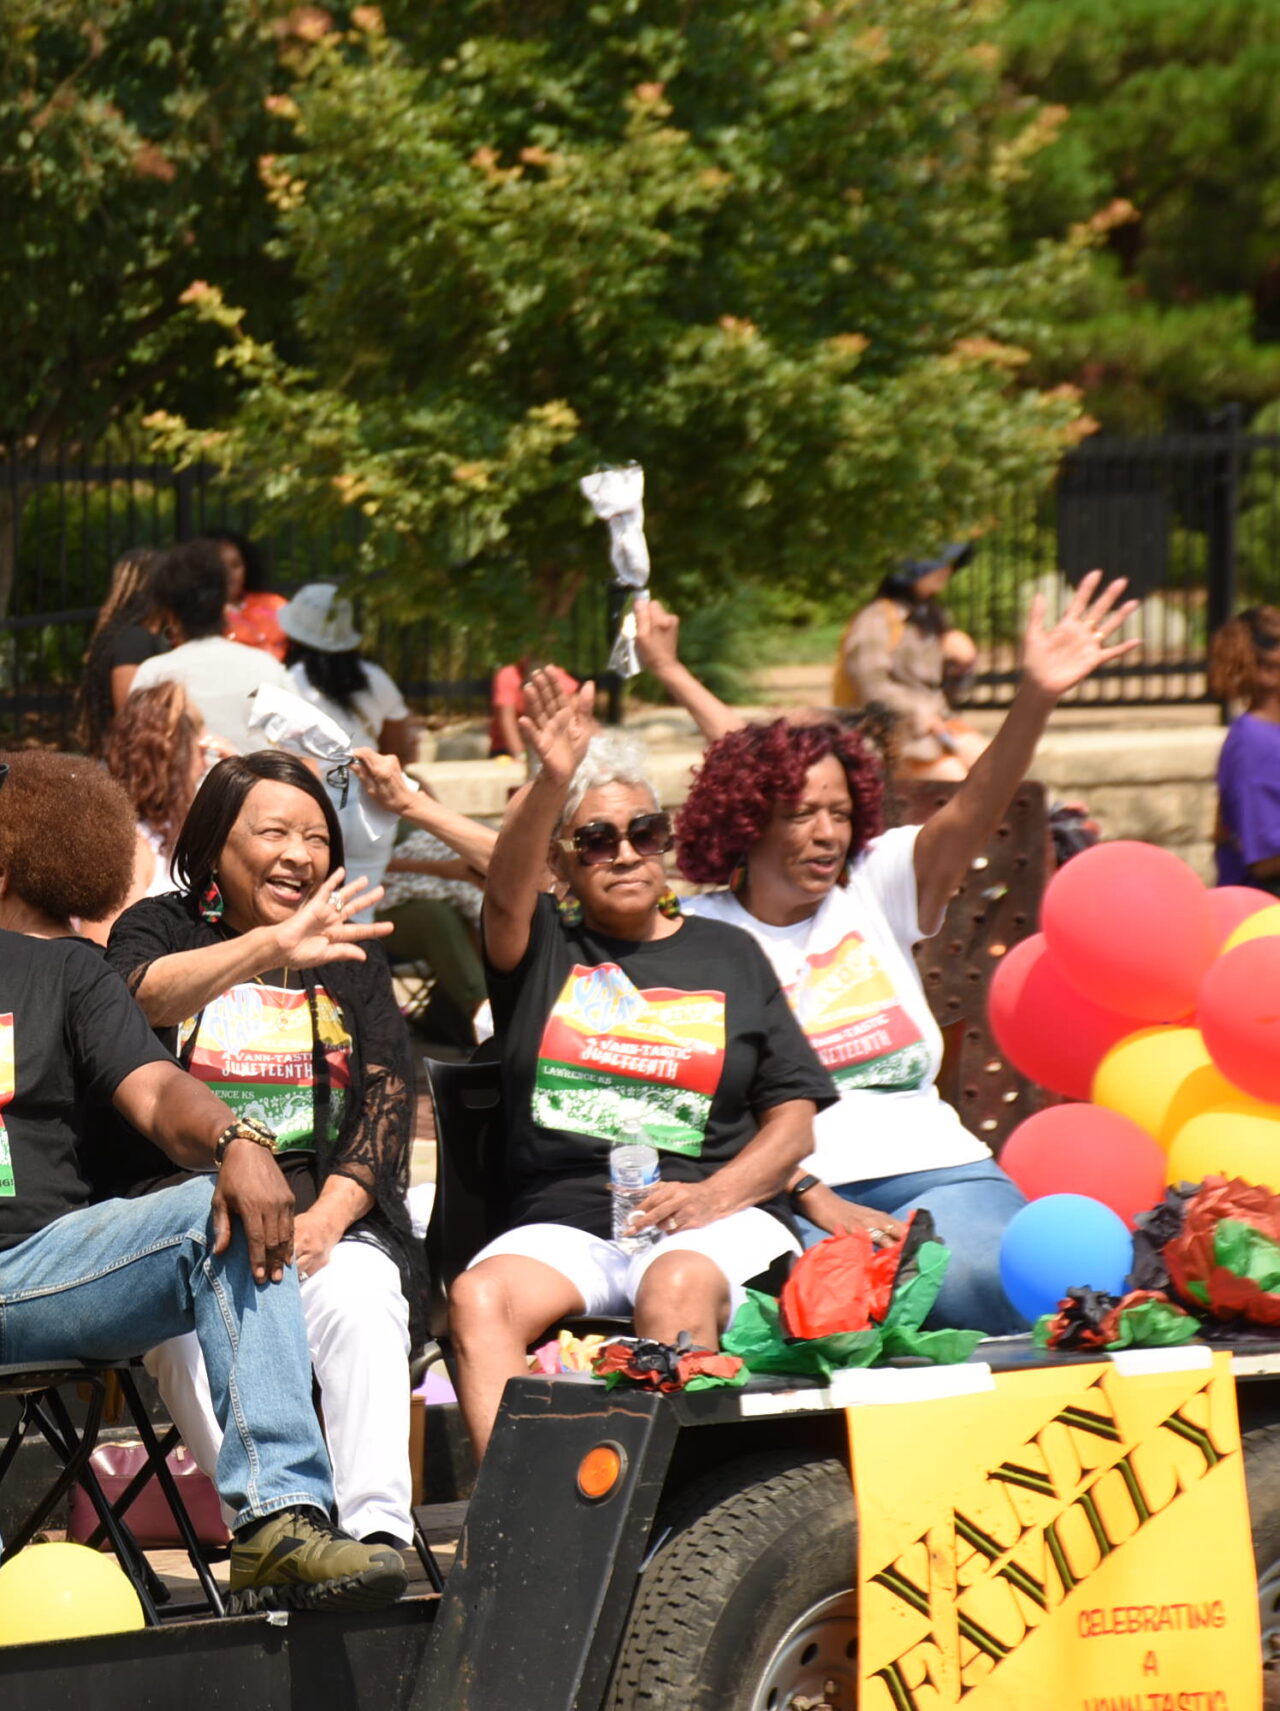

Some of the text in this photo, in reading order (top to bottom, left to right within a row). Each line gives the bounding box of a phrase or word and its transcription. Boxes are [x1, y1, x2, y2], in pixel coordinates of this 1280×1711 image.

[222, 1060, 313, 1078] JUNETEENTH
[233, 1051, 313, 1062] VANN-TASTI
[241, 1091, 255, 1100] KS
[866, 1369, 1126, 1622] VANN
[866, 1379, 1239, 1711] FAMILY
[1078, 1600, 1226, 1639] CELEBRATING
[1142, 1650, 1159, 1677] A
